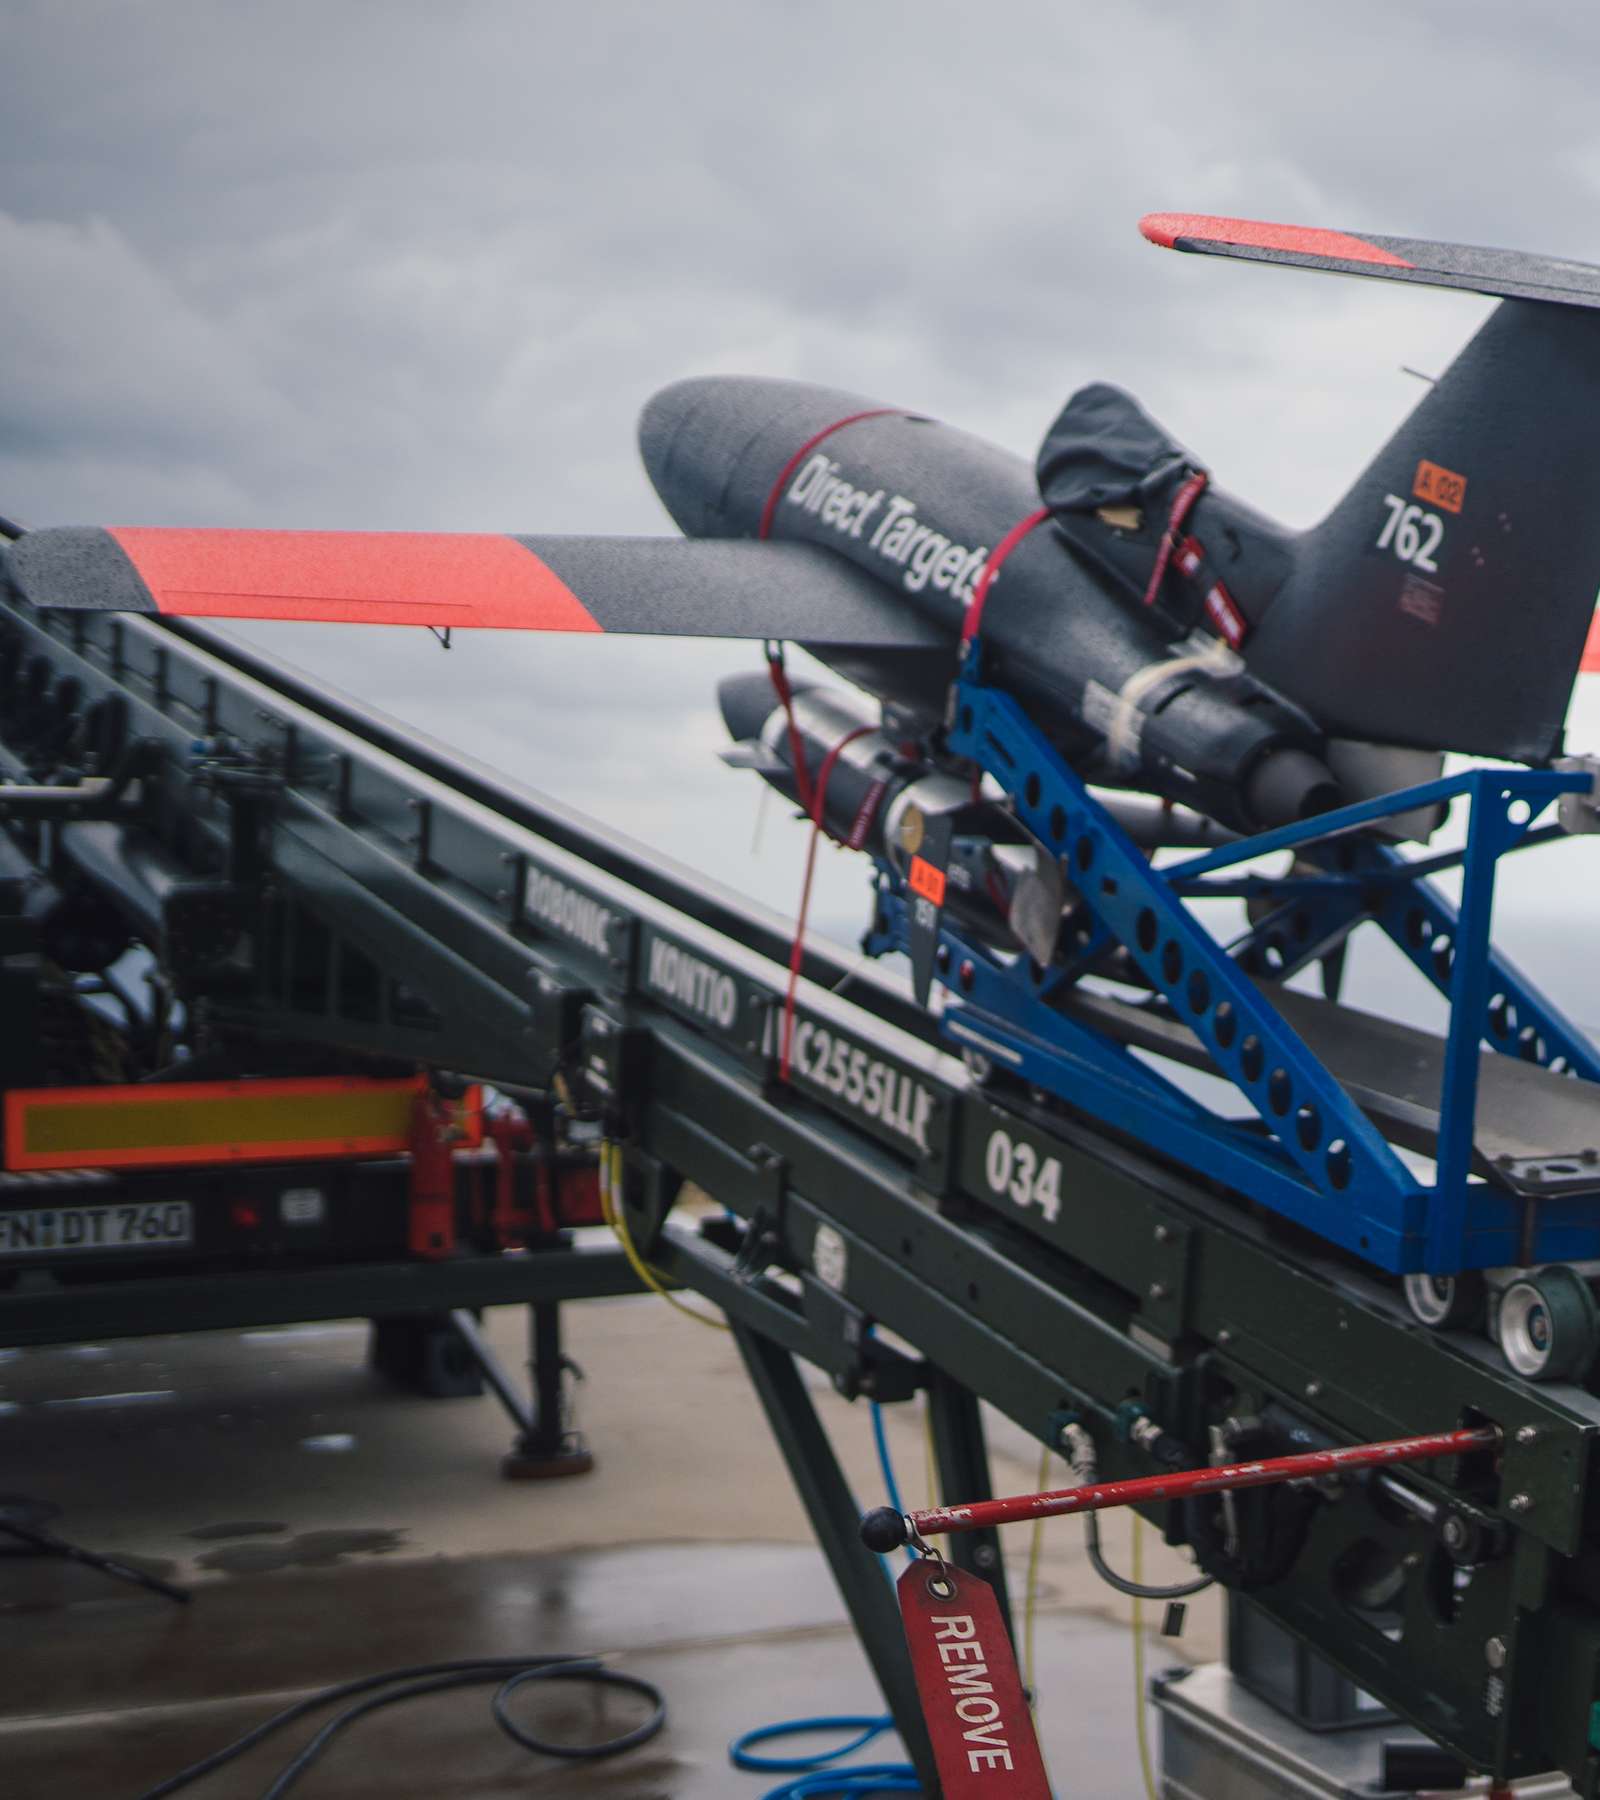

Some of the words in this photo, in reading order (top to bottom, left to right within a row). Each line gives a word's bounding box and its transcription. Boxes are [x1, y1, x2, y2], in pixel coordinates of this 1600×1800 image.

[787, 453, 886, 538] Direct
[1376, 493, 1444, 573] 762
[650, 936, 738, 1029] KONTIO
[986, 1129, 1063, 1223] 034
[61, 1209, 109, 1244] DT
[117, 1204, 183, 1240] 760
[929, 1614, 1015, 1774] REMOVE
